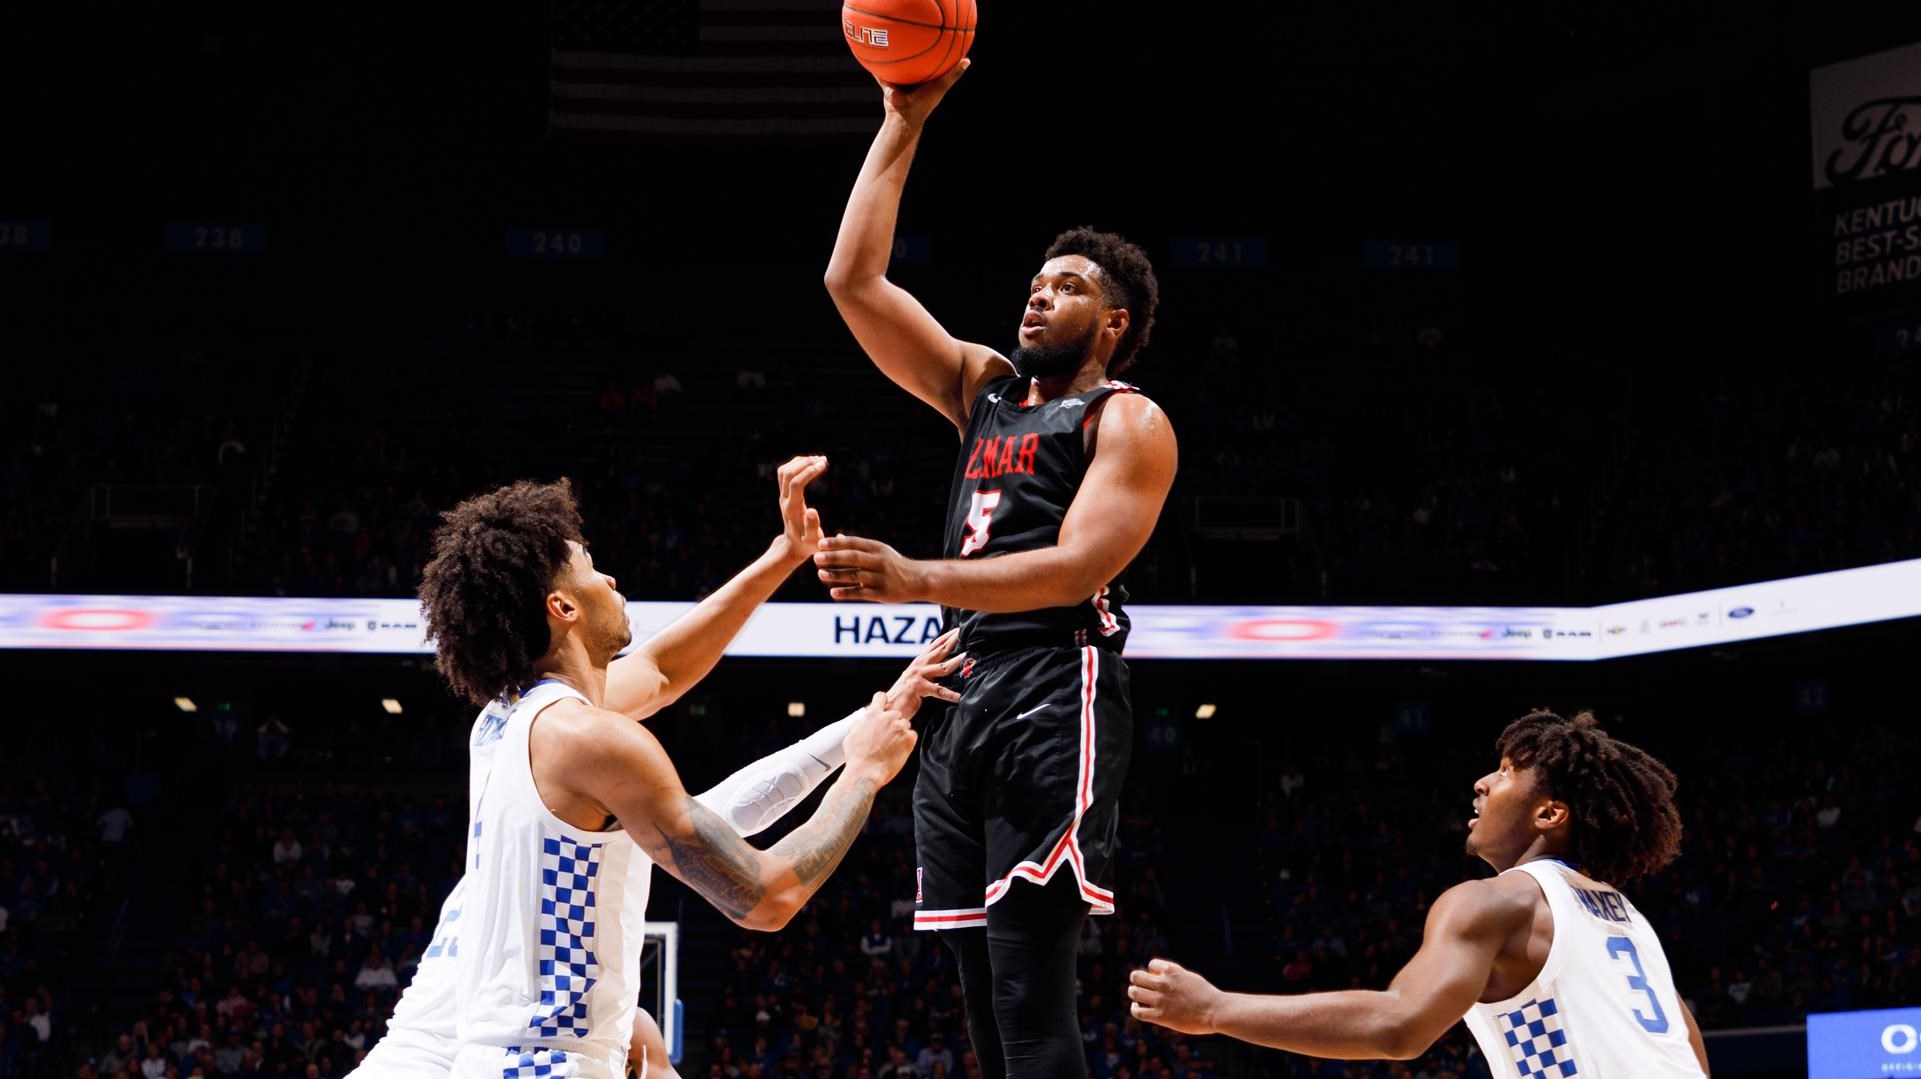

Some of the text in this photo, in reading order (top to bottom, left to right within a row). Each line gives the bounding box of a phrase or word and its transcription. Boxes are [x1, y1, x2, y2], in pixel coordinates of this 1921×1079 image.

[845, 22, 888, 47] ELITE
[1833, 196, 1921, 238] KENTU
[193, 225, 243, 248] 238
[532, 231, 582, 253] 240
[1835, 225, 1921, 265] BEST-S
[1195, 241, 1244, 265] 241
[1387, 244, 1434, 265] 241
[961, 489, 1002, 558] 5
[1606, 936, 1669, 1034] 3
